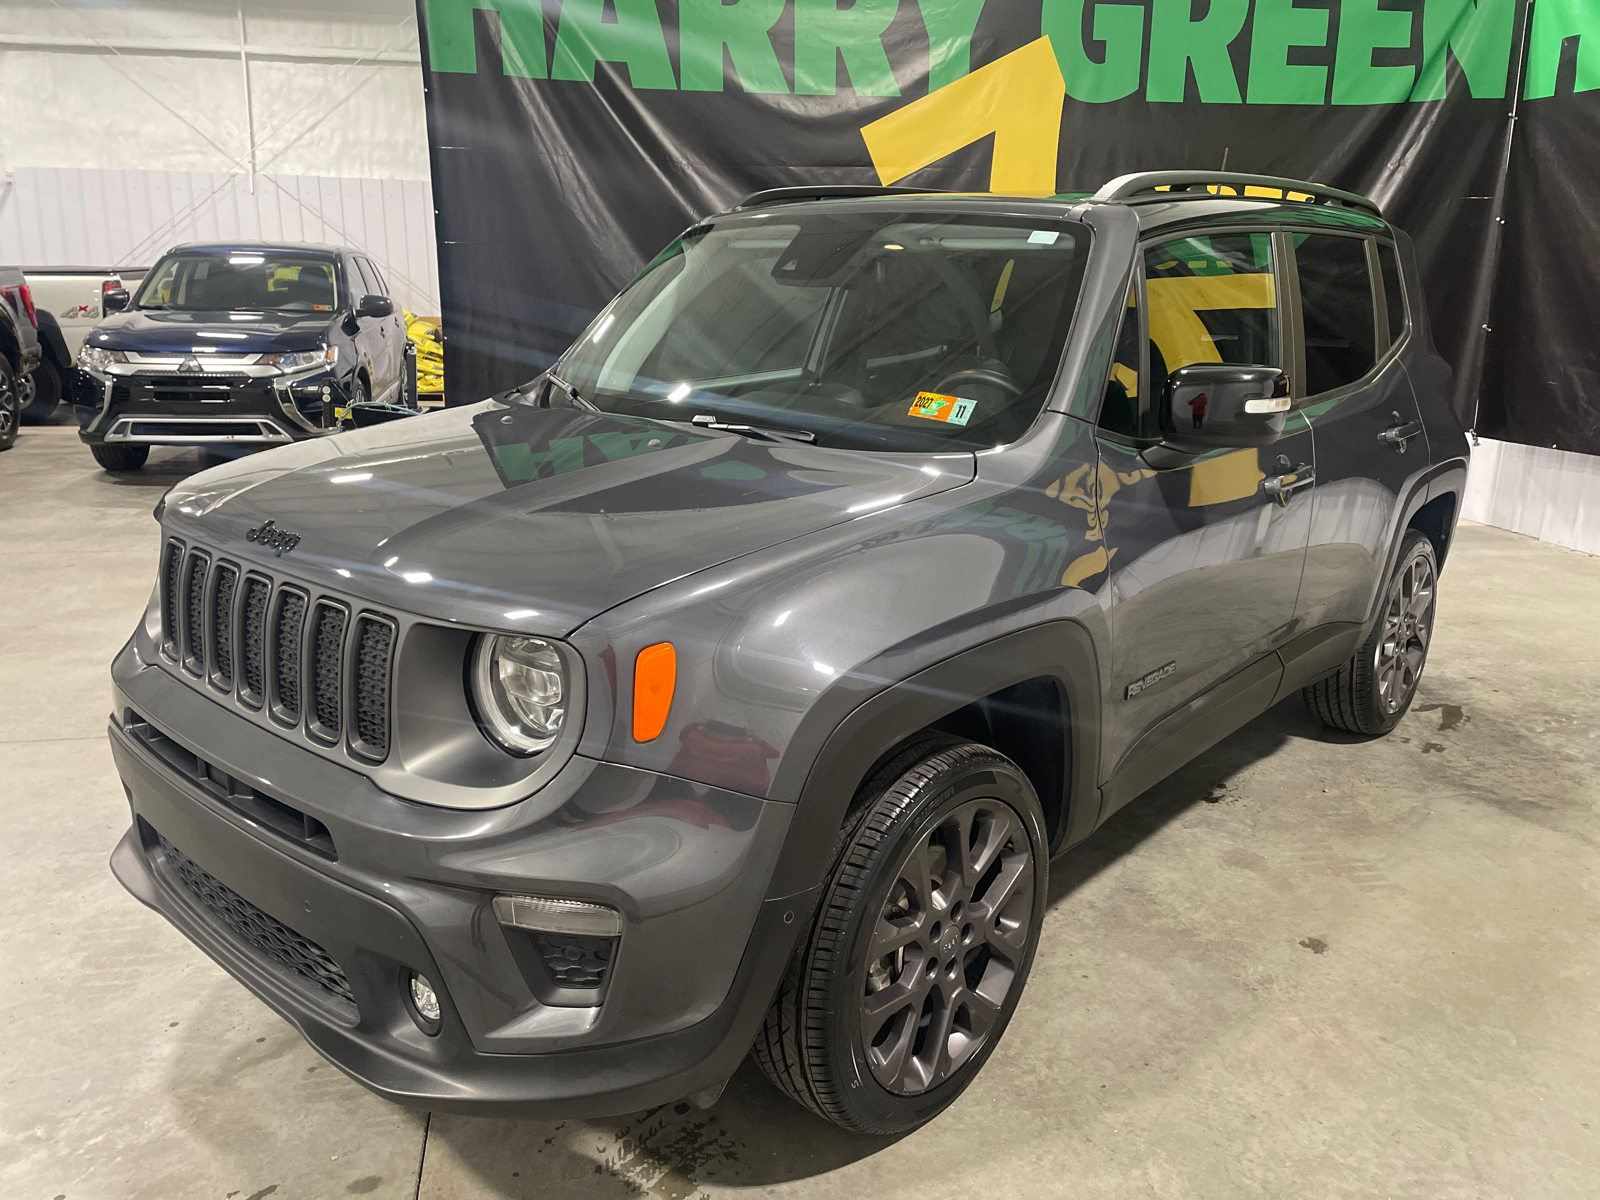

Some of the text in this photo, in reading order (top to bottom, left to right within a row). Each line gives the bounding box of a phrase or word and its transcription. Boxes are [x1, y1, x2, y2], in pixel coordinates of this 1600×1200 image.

[1041, 0, 1516, 105] GREEN
[246, 519, 301, 557] Jeep
[1123, 660, 1176, 700] RENEGADE
